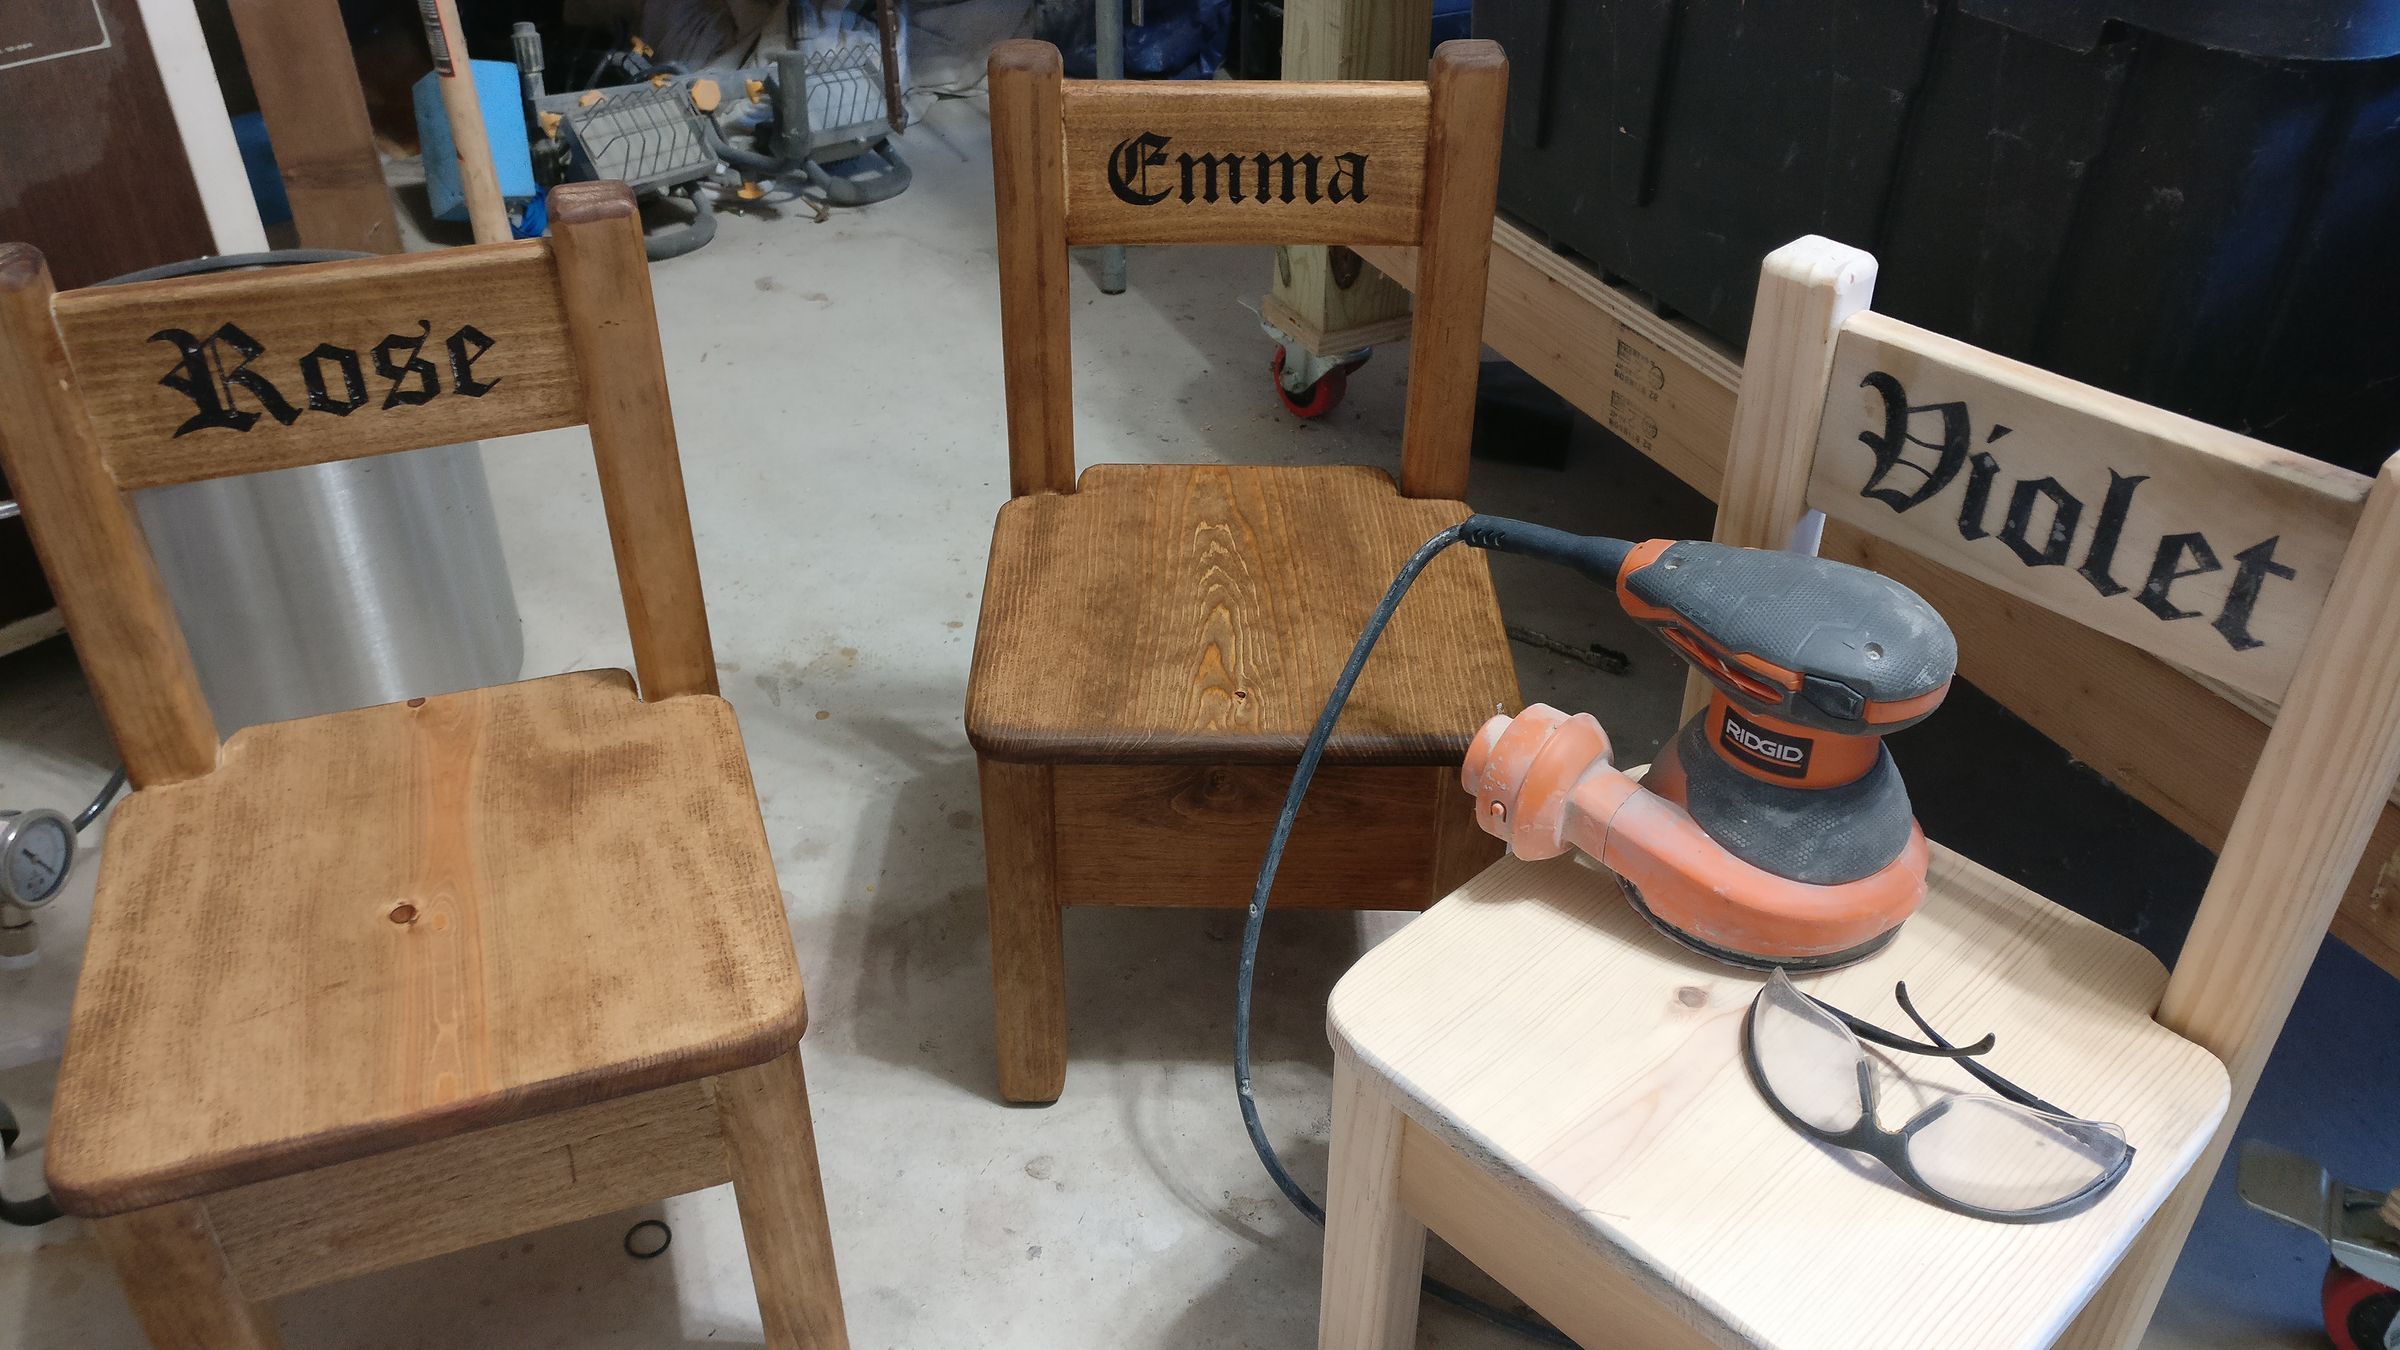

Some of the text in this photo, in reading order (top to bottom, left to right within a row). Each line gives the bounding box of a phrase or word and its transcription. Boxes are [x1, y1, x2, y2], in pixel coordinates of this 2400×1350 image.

[1107, 131, 1369, 205] Emma
[146, 319, 501, 438] Rose
[1858, 371, 2296, 651] Violet
[1726, 718, 1804, 762] RIDGID
